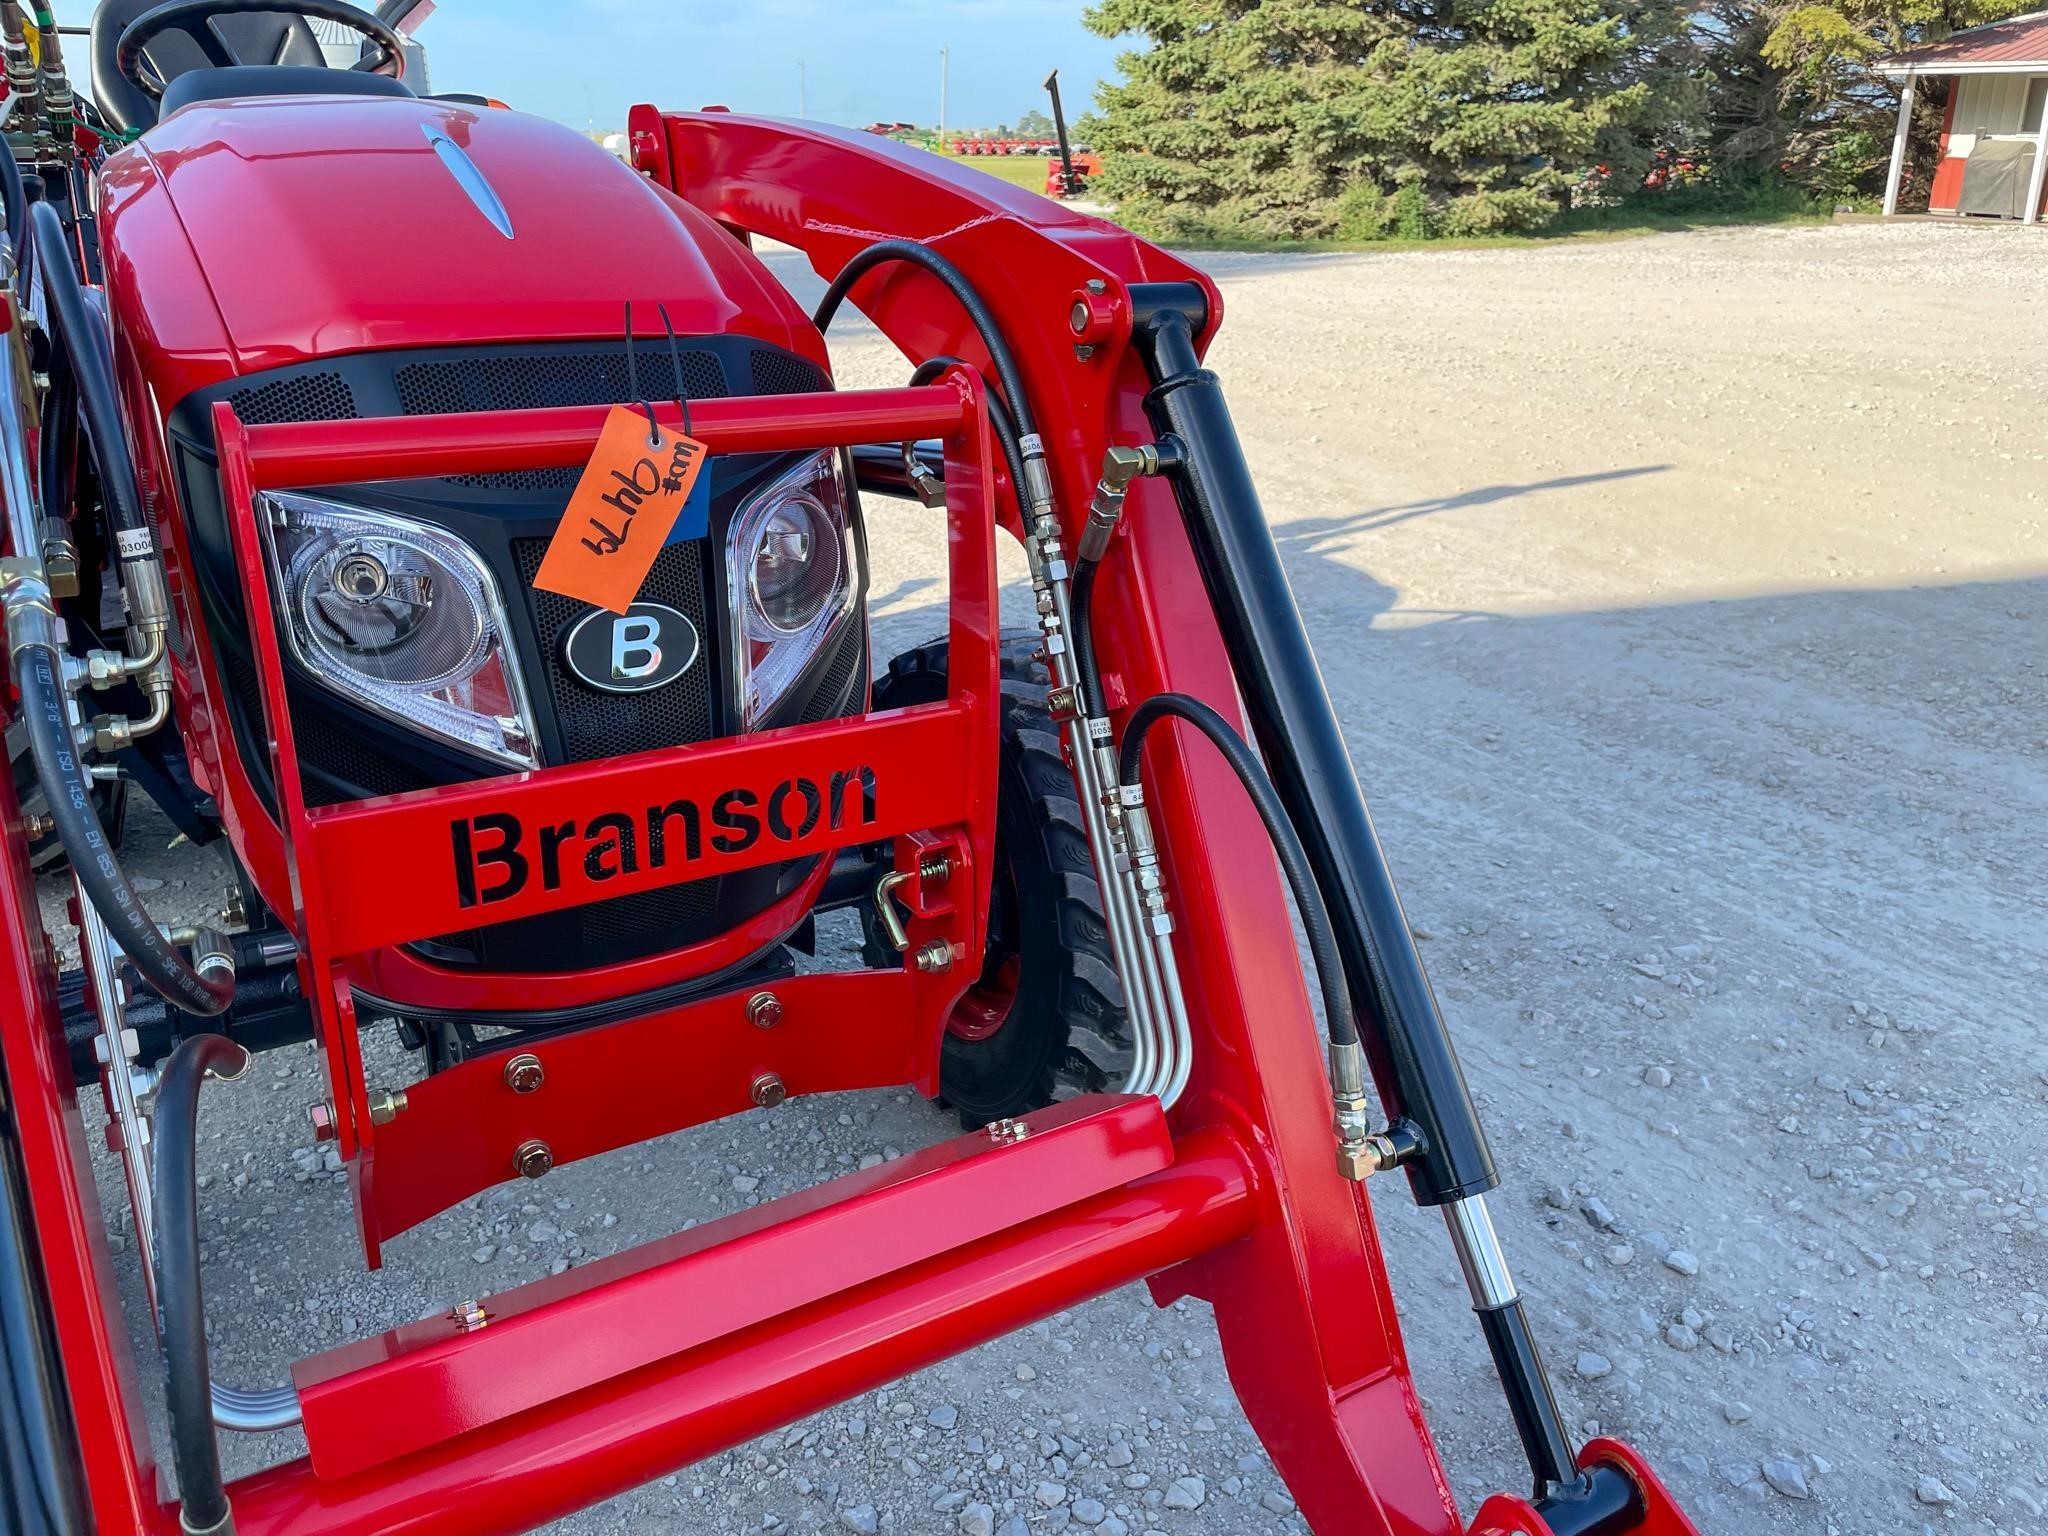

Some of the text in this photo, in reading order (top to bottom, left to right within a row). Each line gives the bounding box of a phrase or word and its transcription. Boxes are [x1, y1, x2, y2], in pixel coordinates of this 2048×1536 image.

[580, 458, 661, 556] 9479
[611, 615, 662, 680] B
[56, 750, 75, 771] ISO
[65, 779, 88, 809] 1436
[85, 830, 103, 849] EN
[450, 764, 876, 910] Branson
[97, 853, 117, 879] 853
[127, 911, 144, 929] DN
